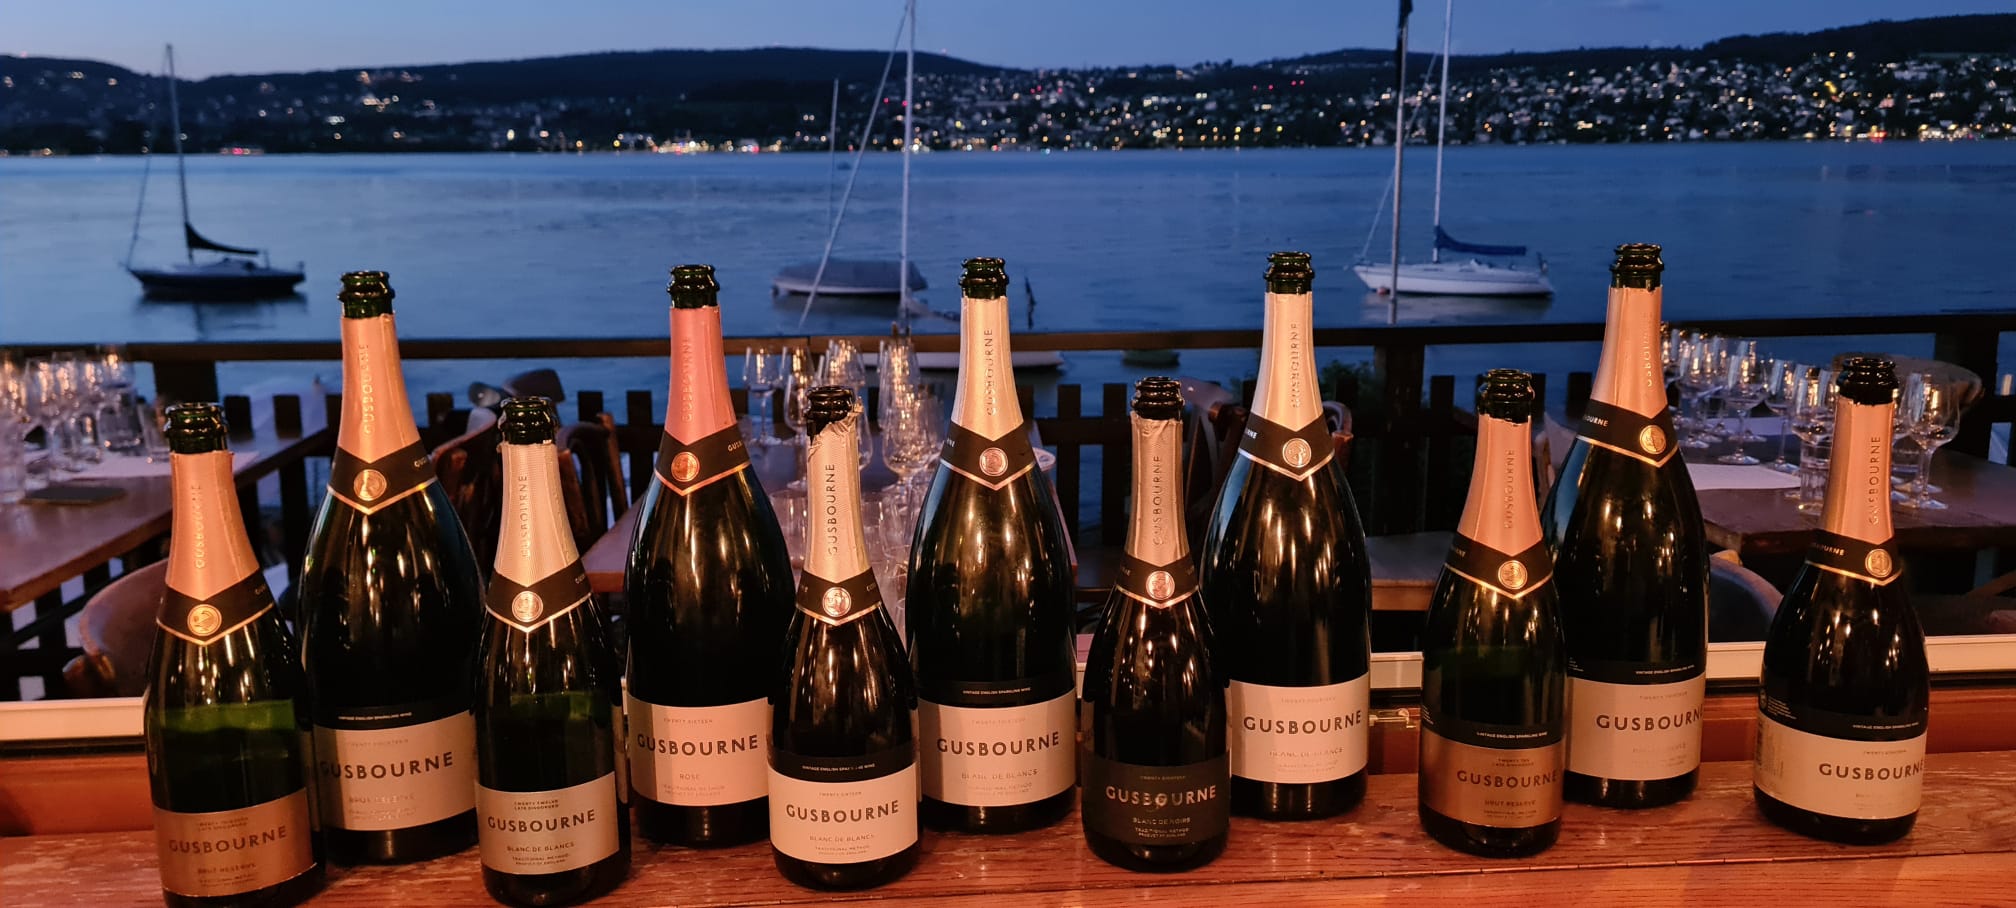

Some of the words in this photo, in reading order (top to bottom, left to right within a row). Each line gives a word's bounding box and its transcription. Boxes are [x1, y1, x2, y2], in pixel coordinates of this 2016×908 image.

[984, 328, 997, 417] GUSBOURNE
[1868, 436, 1881, 525] GUSBOURNE
[825, 464, 838, 555] GUSBOURNE
[1153, 456, 1164, 546] GUSBOURNE
[1243, 710, 1362, 734] GUSBOURNE
[1596, 703, 1703, 731] GUSBOURN
[637, 734, 758, 755] GUSBOURNE
[937, 731, 1060, 756] GUSBOURNE
[320, 752, 453, 779] GUSBOURNE
[1457, 769, 1558, 788] GUSBOURNE
[1106, 785, 1217, 806] GUSBOURNE
[488, 809, 595, 832] GUSBOURNE
[786, 800, 899, 823] GUSBOURNE
[168, 825, 288, 854] GUSBOURNE
[544, 841, 575, 852] BLANCS
